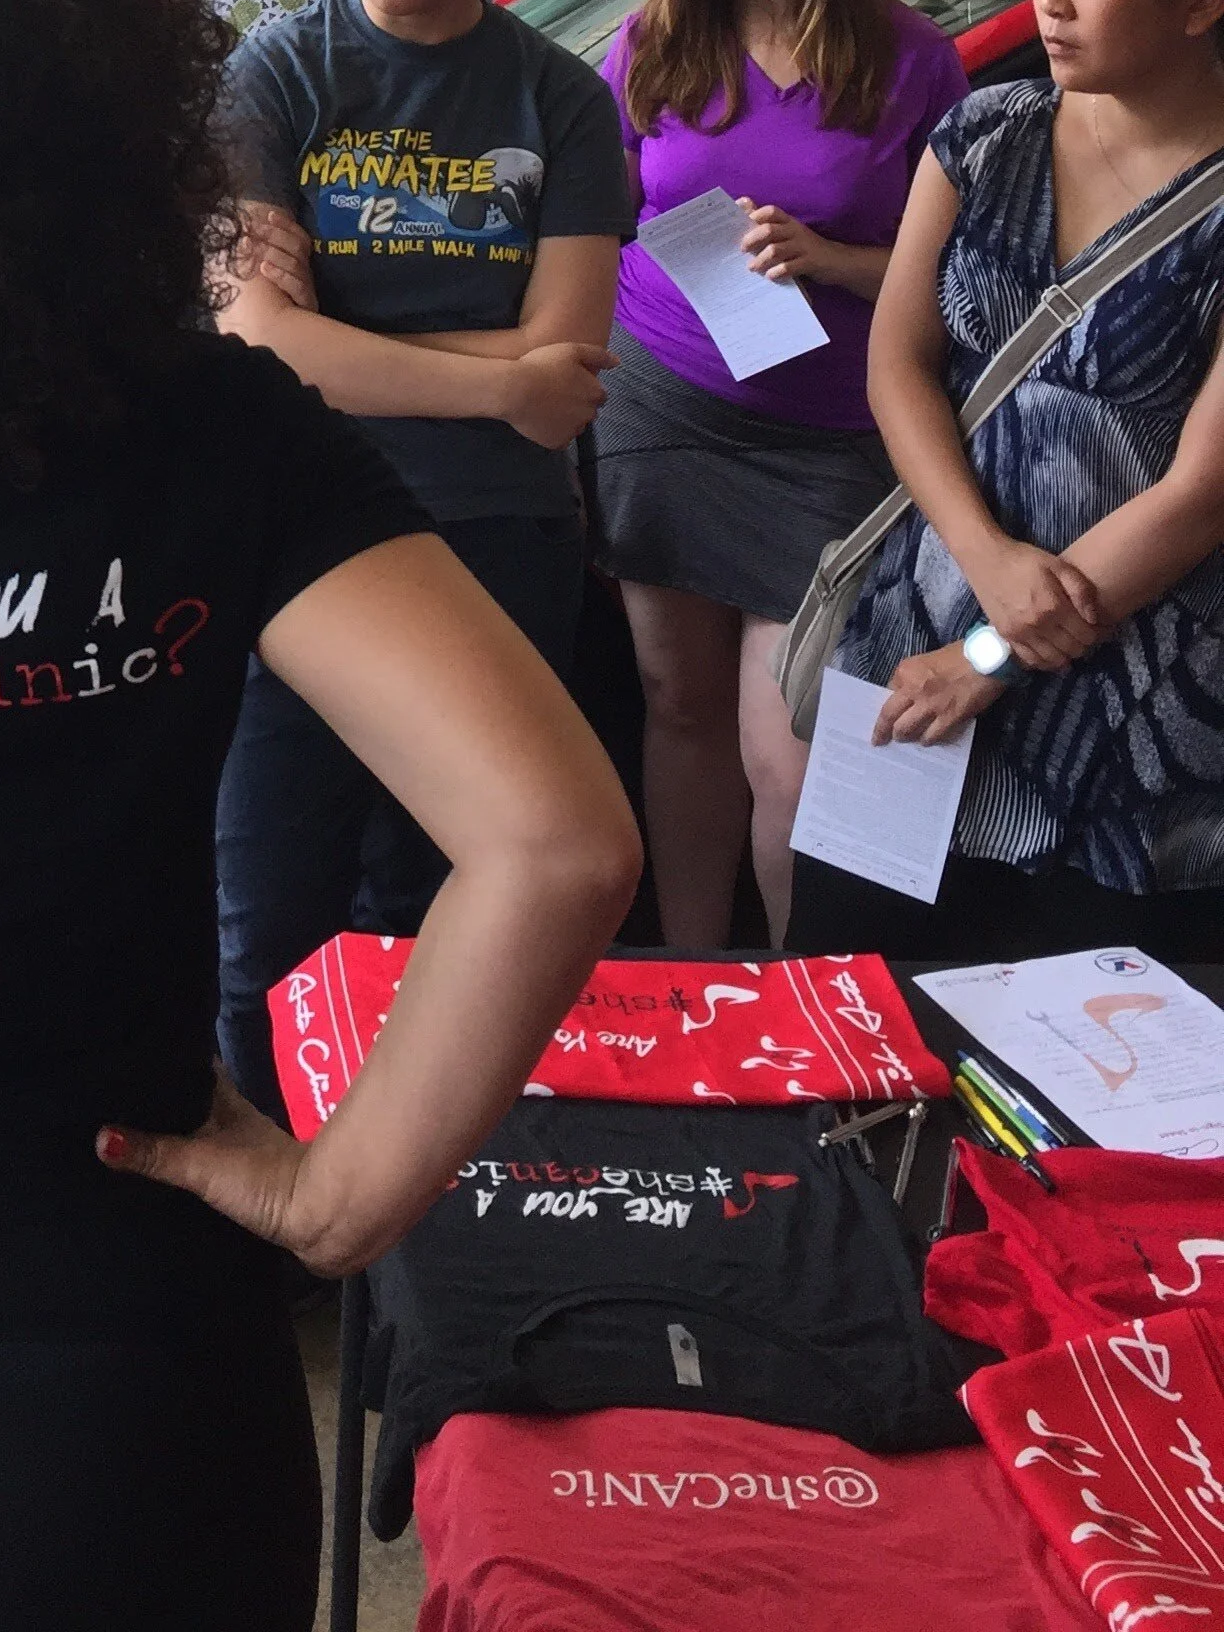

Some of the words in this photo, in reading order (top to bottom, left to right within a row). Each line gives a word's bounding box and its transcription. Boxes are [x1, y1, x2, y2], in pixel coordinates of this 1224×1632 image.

[325, 128, 384, 149] SAVE
[390, 128, 433, 151] THE
[299, 151, 496, 195] MANATEE
[393, 221, 445, 236] ANNUAL
[328, 239, 358, 255] RUN
[372, 239, 383, 254] 2
[389, 239, 425, 255] MILE
[432, 240, 476, 258] WALK
[85, 557, 127, 632] A
[596, 1030, 658, 1058] Are
[476, 1189, 495, 1218] A
[523, 1187, 631, 1219] YOU
[624, 1196, 694, 1229] ARE
[549, 1465, 880, 1511] @sheCANic
